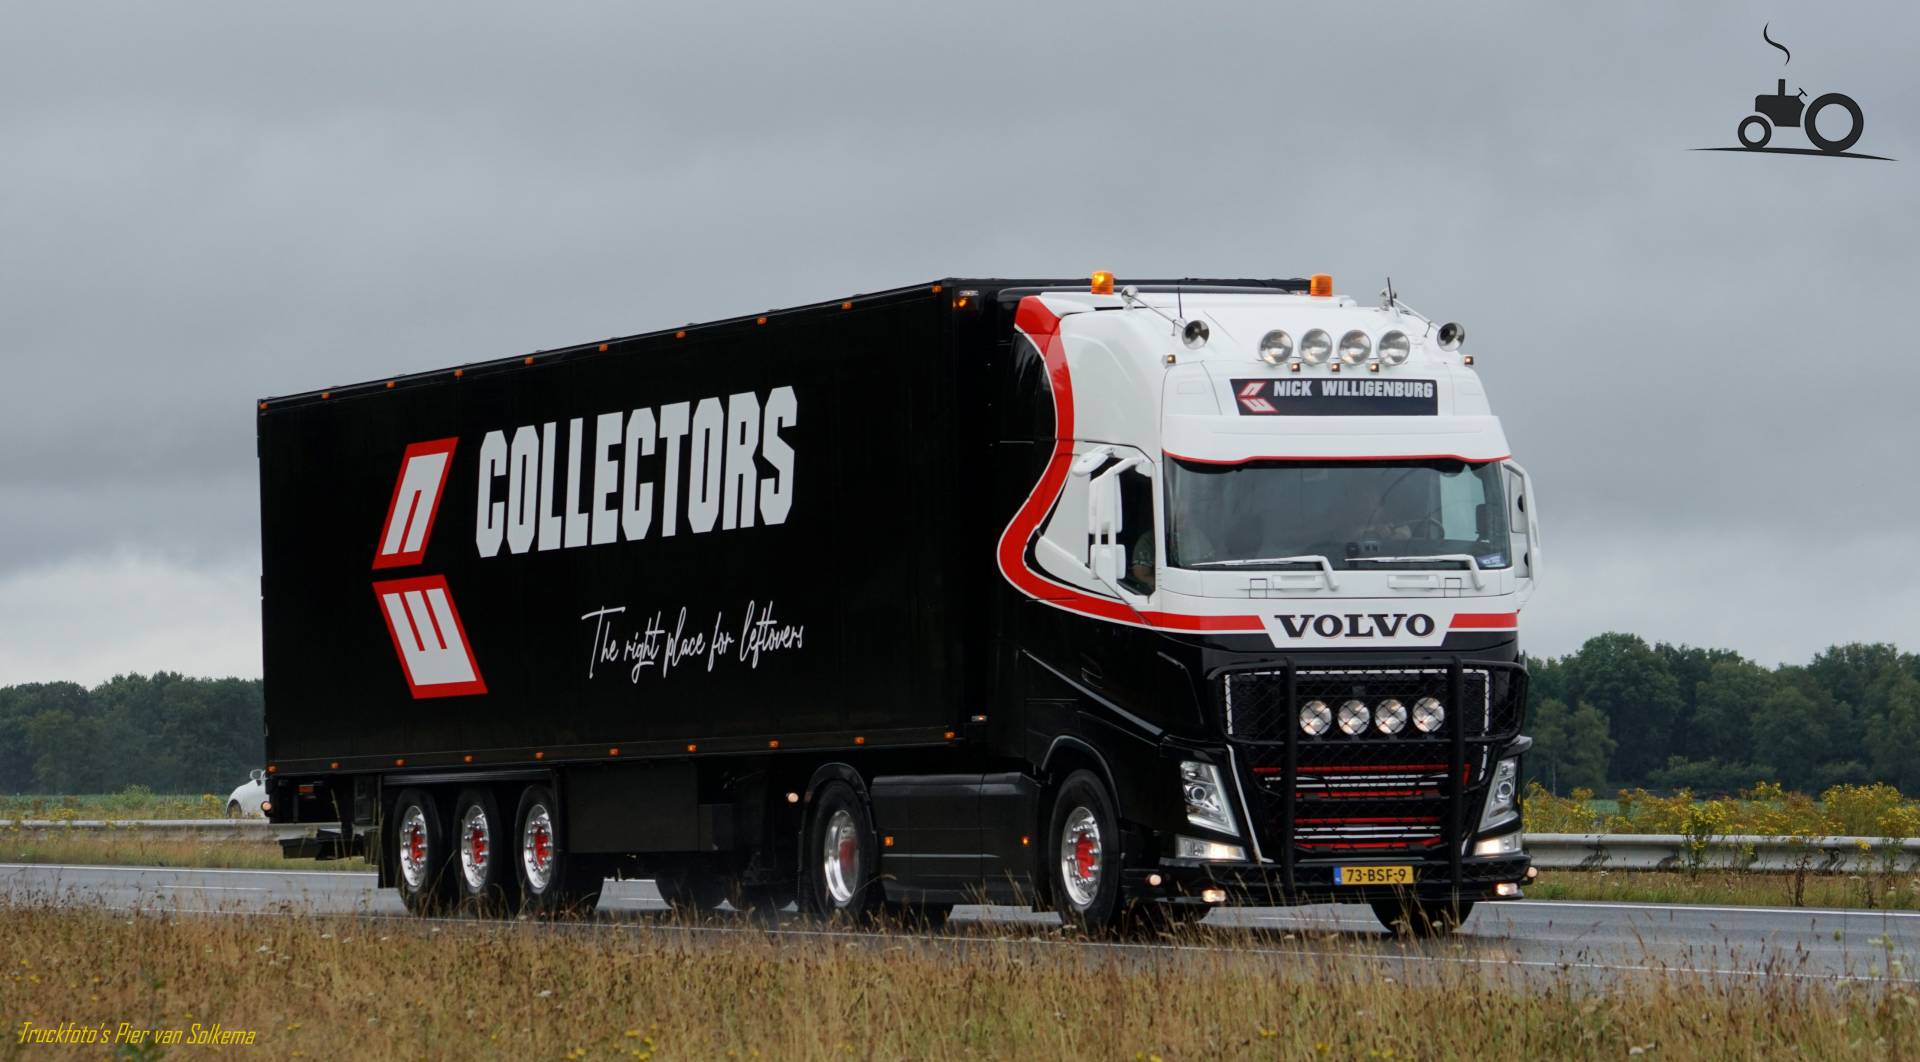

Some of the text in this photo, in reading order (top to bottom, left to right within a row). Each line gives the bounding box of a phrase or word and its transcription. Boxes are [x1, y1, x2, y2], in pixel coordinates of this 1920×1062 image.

[1273, 380, 1434, 398] NICK WILLIGENBURG
[475, 385, 798, 558] COLLECTORS
[1274, 613, 1436, 638] VOLVO
[581, 599, 804, 684] The right place for leftovers
[1346, 868, 1407, 882] 73-BSF-9
